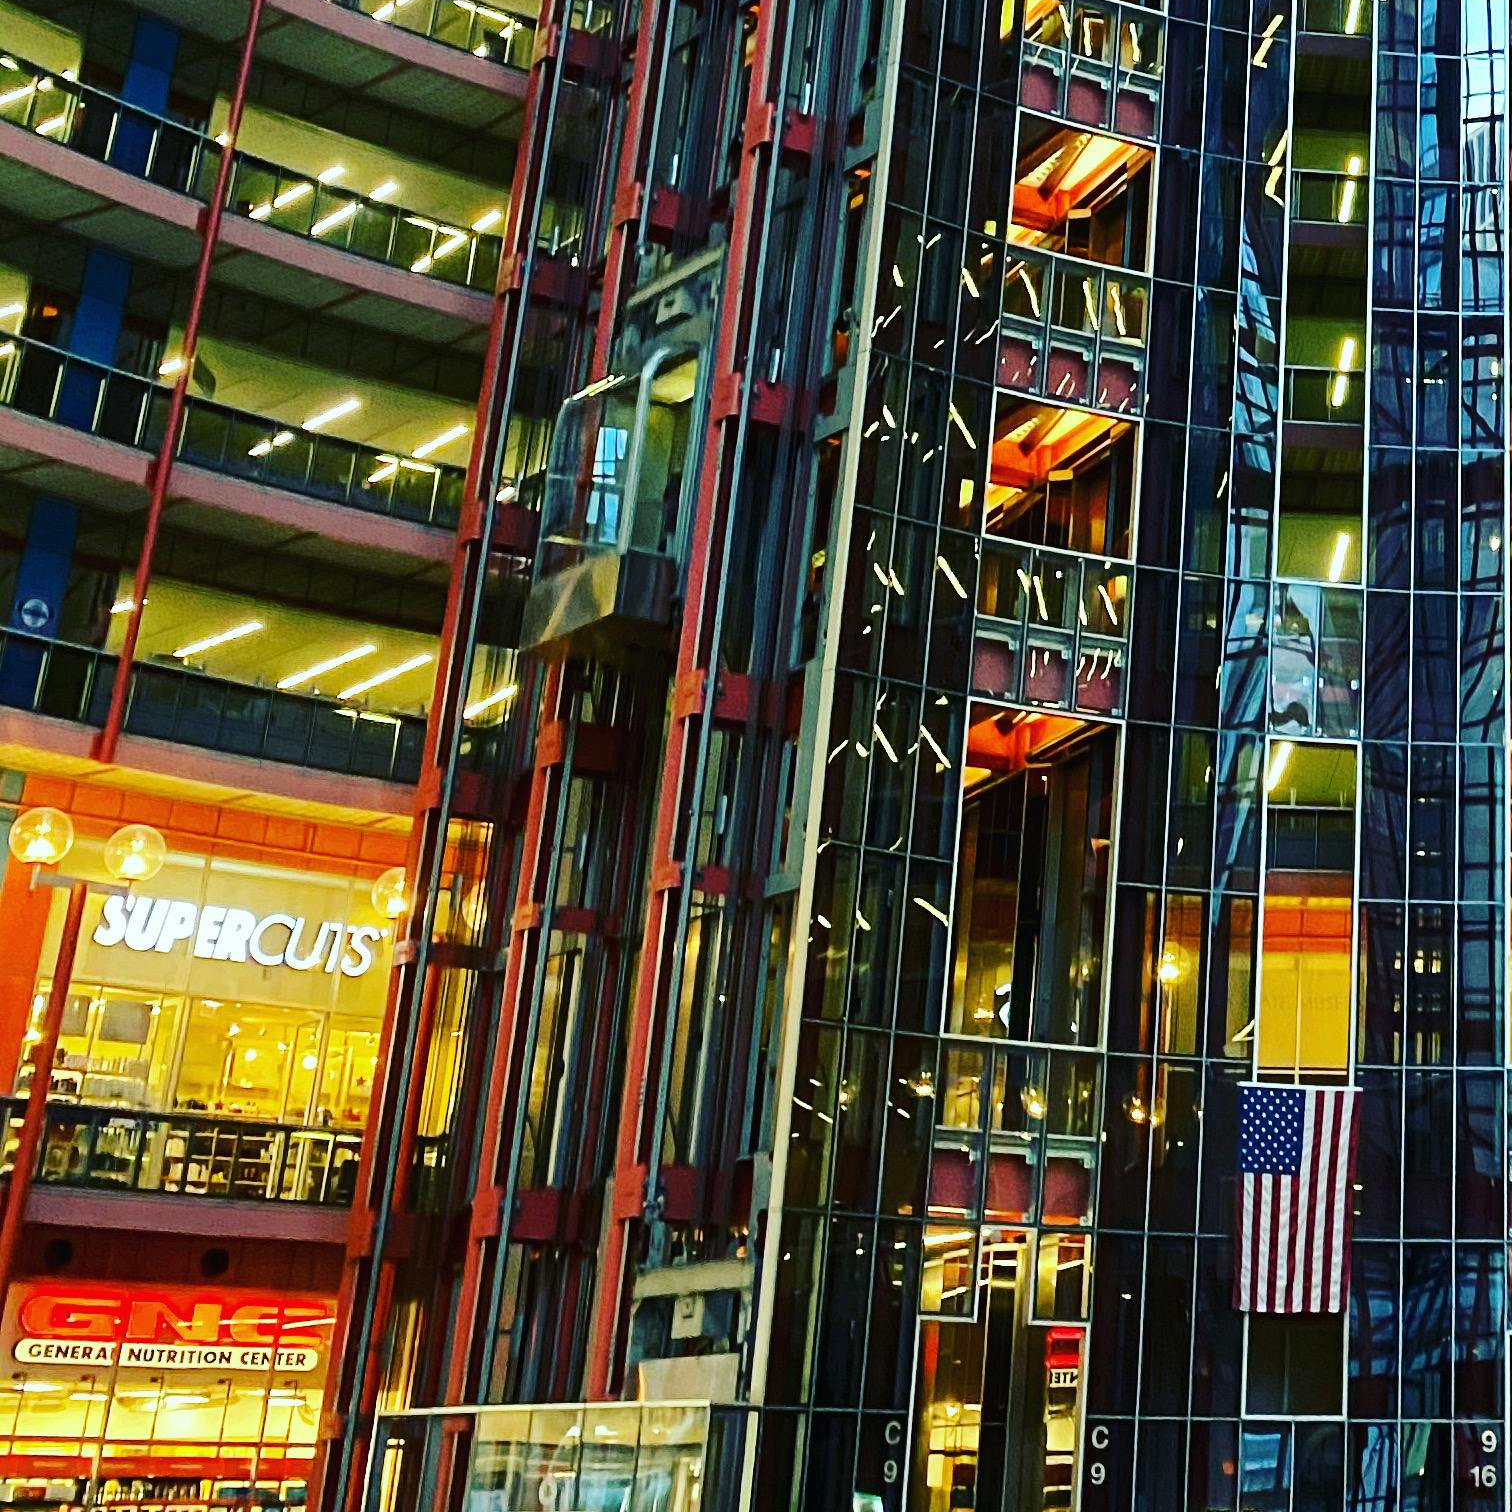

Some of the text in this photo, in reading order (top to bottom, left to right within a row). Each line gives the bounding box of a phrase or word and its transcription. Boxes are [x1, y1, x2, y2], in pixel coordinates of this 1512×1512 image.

[92, 894, 380, 977] SUPERCUTS
[20, 1294, 327, 1346] GNC
[28, 1343, 307, 1366] GENERA NUTRITION CENTER
[884, 1420, 901, 1445] C
[1091, 1425, 1109, 1450] C
[1480, 1430, 1497, 1453] 9
[883, 1460, 898, 1483] 9
[1090, 1462, 1106, 1485] 9
[1470, 1465, 1497, 1488] 16
